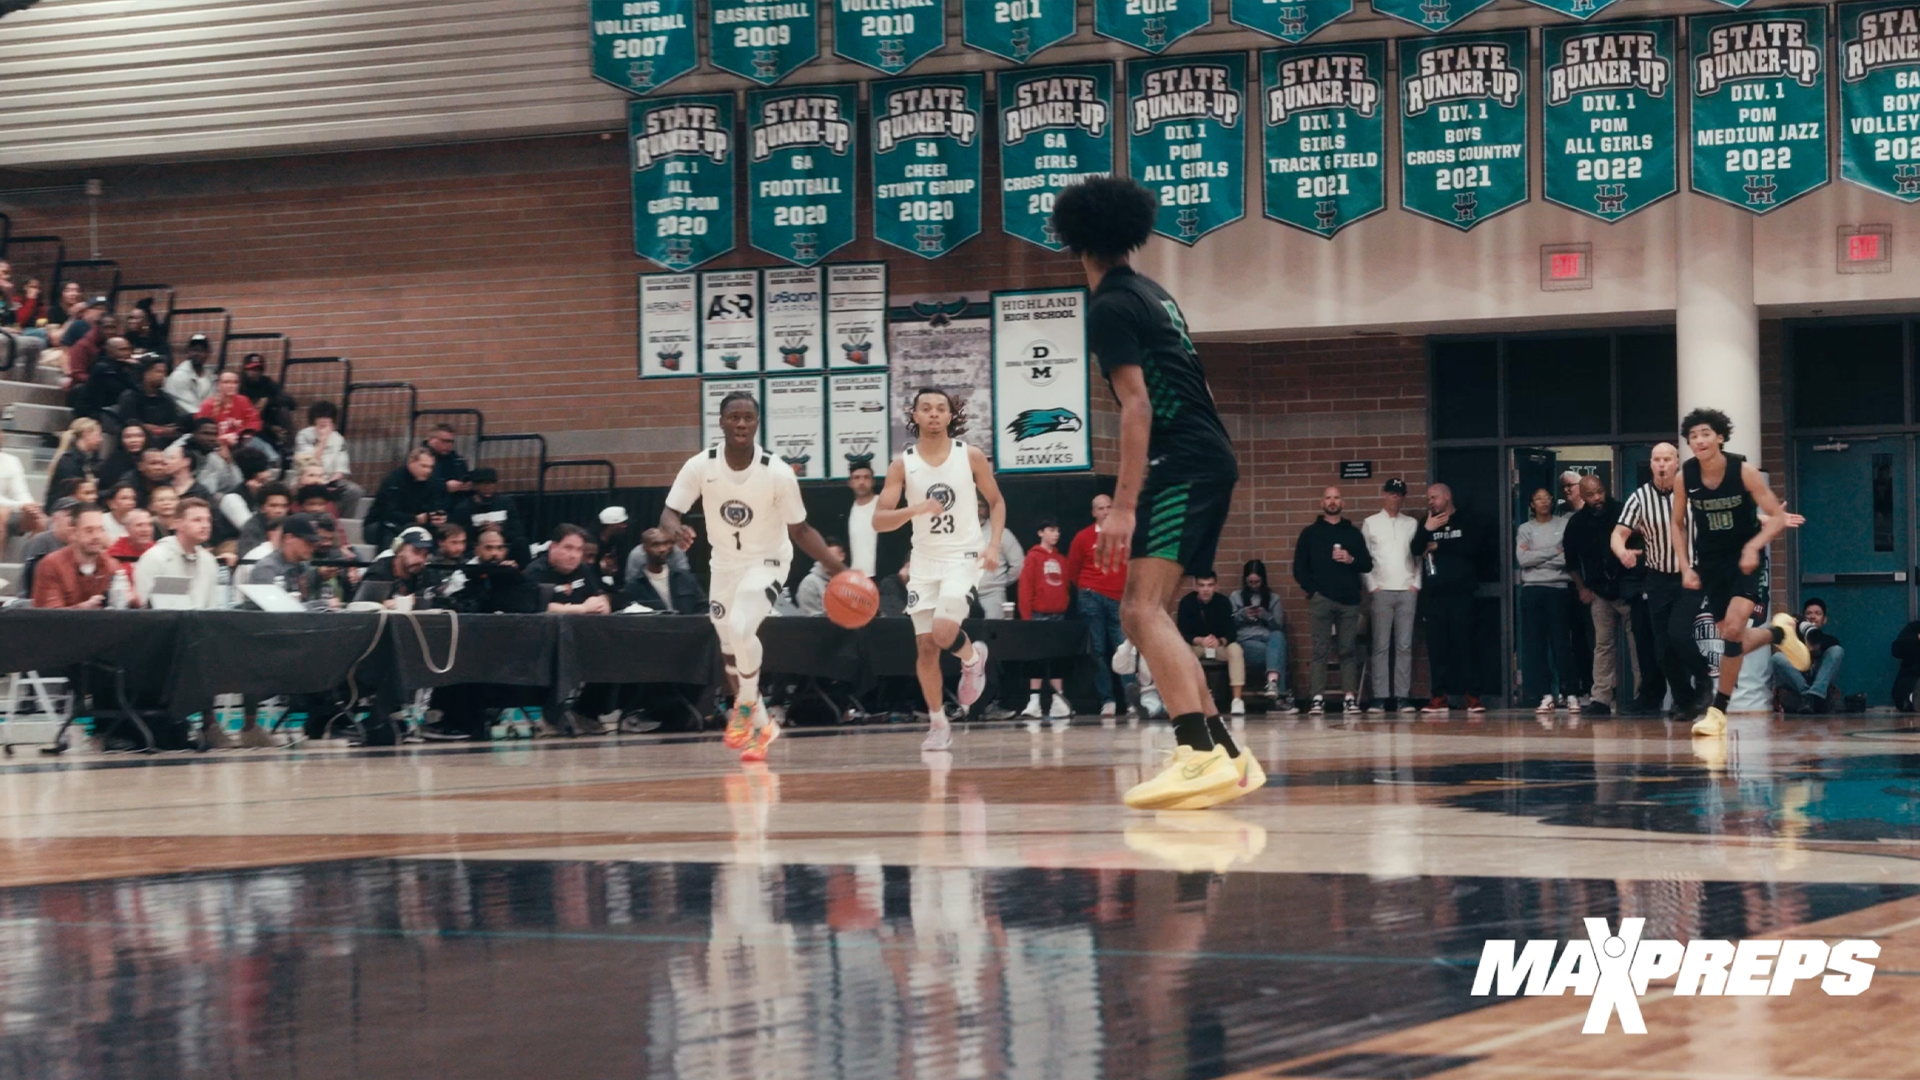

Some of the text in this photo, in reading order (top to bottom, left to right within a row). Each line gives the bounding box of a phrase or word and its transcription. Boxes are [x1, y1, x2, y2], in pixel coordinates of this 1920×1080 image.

[623, 1, 660, 16] BOYS
[715, 2, 810, 25] BASKETBALL
[995, 0, 1042, 23] 2011
[595, 13, 687, 36] VOLLEYBALL
[861, 13, 915, 37] 2010
[1862, 9, 1920, 41] STA
[613, 36, 669, 59] 2007
[734, 25, 791, 48] 2009
[1712, 23, 1803, 55] STATE
[1420, 46, 1506, 77] STATE
[1565, 35, 1653, 66] STATE
[1848, 34, 1920, 79] RUNNE
[1146, 67, 1227, 96] STATE
[1282, 57, 1364, 87] STATE
[1552, 60, 1666, 103] RUNNER-UP
[1699, 48, 1818, 93] RUNNER-UP
[889, 87, 965, 117] STATE
[1017, 78, 1094, 108] STATE
[1269, 80, 1377, 122] RUNNER-UP
[1408, 70, 1518, 113] RUNNER-UP
[1582, 93, 1637, 113] DIV. 1
[1731, 82, 1785, 103] DIV. 1
[1882, 93, 1920, 113] BOY
[647, 106, 718, 134] STATE
[764, 97, 839, 125] STATE
[1006, 101, 1106, 143] RUNNER-UP
[1134, 91, 1239, 132] RUNNER-UP
[1299, 112, 1347, 132] DIV. 1
[1438, 103, 1489, 123] DIV. 1
[1738, 106, 1778, 124] POM
[878, 110, 975, 151] RUNNER-UP
[1164, 123, 1207, 141] DIV. 1
[1444, 126, 1483, 144] BOYS
[1590, 117, 1629, 134] POM
[1697, 122, 1820, 147] MEDIUM JAZZ
[1850, 113, 1920, 136] VOLLEY
[637, 128, 728, 169] RUNNER-UP
[755, 120, 849, 158] RUNNER-UP
[915, 142, 939, 158] 5A
[1043, 133, 1068, 150] 6A
[1299, 134, 1347, 153] GIRLS
[1564, 134, 1654, 156] ALL GIRLS
[1874, 136, 1920, 163] 202
[791, 154, 814, 170] 6A
[1034, 155, 1079, 170] GIRLS
[1169, 143, 1203, 161] POM
[1268, 151, 1379, 174] TRACK & FIELD
[1406, 143, 1523, 166] CROSS COUNTRY
[1725, 146, 1792, 173] 2022
[691, 161, 699, 174] 1
[905, 163, 949, 178] CHEER
[1144, 161, 1229, 183] ALL GIRLS
[1436, 164, 1492, 191] 2021
[1576, 156, 1644, 182] 2022
[760, 177, 842, 198] FOOTBALL
[877, 178, 976, 199] STUNT GROUP
[1003, 174, 1046, 192] CROSS
[1160, 182, 1212, 207] 2021
[1297, 173, 1351, 199] 2021
[900, 200, 955, 222] 2020
[1028, 192, 1056, 215] 20
[657, 215, 708, 238] 2020
[774, 204, 828, 227] 2020
[1850, 235, 1880, 260] EXIT
[1551, 253, 1580, 279] EXIT
[707, 293, 755, 321] ASR
[1001, 296, 1078, 311] HIGHLAND
[1032, 346, 1050, 359] D
[1031, 366, 1052, 379] M
[1015, 453, 1074, 466] HAWKS
[930, 514, 956, 535] 23
[1706, 511, 1735, 531] 10
[732, 530, 743, 551] 1
